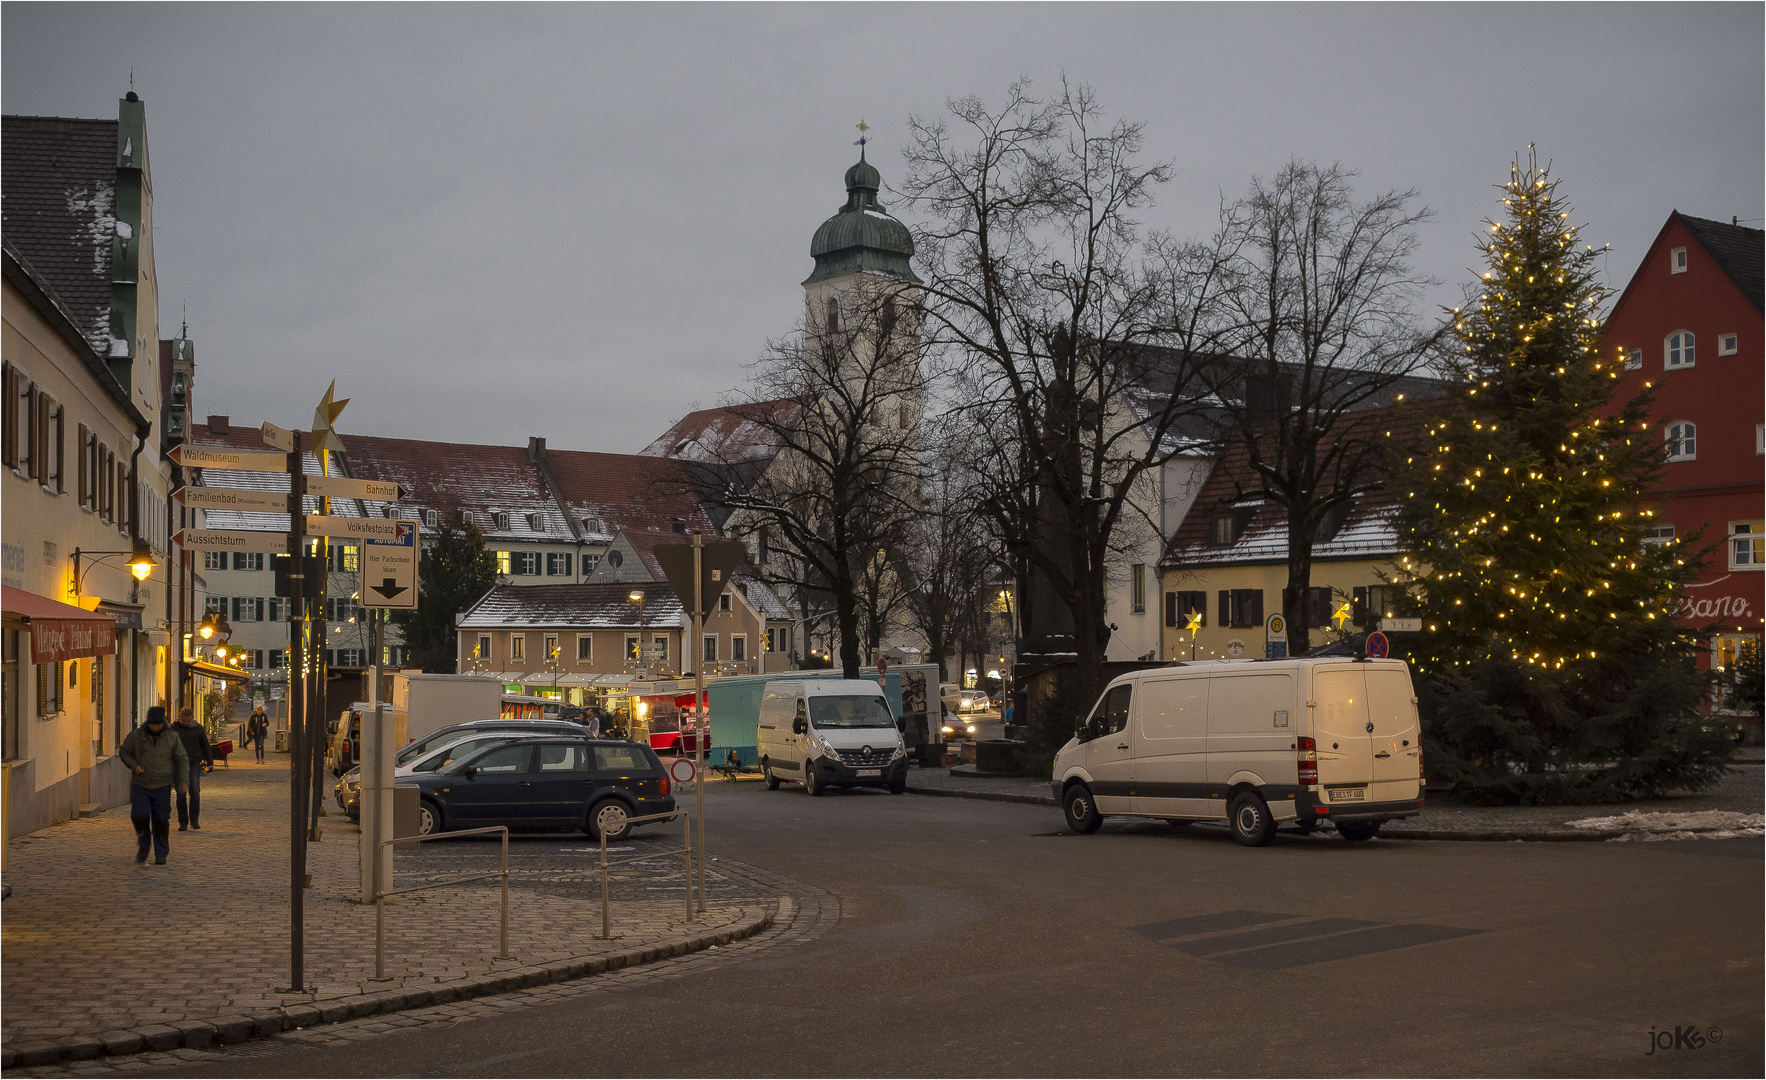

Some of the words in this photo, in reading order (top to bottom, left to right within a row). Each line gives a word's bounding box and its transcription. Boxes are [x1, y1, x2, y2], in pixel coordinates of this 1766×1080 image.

[184, 449, 240, 463] Waldmuseum
[366, 484, 396, 496] Bahnhof
[187, 491, 236, 503] Familienbad
[347, 522, 394, 534] Volksfestplatz
[187, 533, 246, 546] Aussichtsturm
